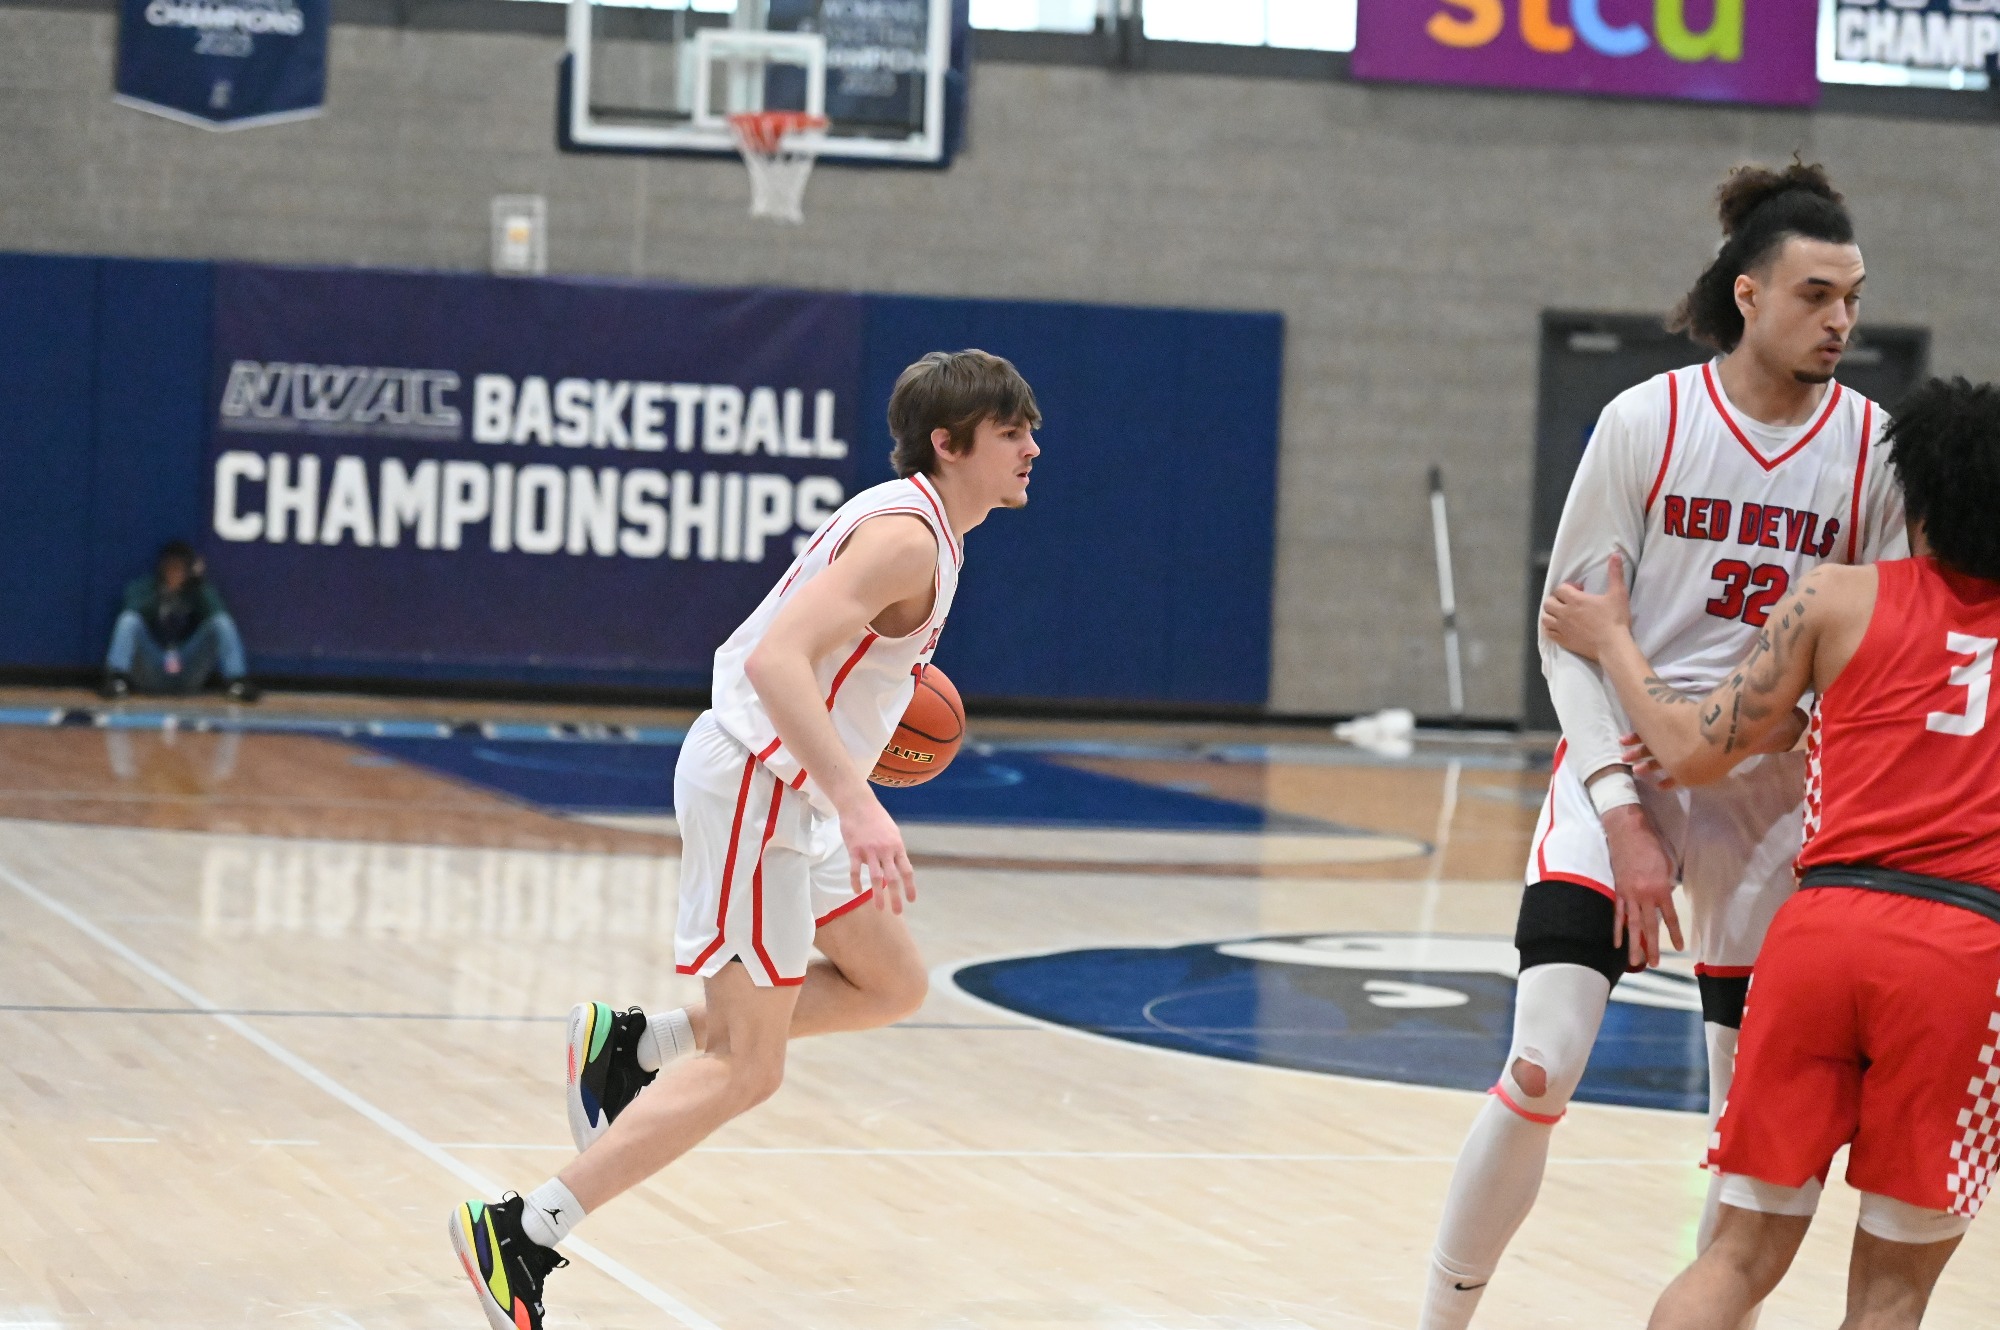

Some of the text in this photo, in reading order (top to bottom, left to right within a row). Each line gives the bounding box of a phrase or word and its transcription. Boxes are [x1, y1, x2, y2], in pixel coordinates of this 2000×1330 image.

[220, 359, 848, 459] NWAC BASKETBALL
[213, 450, 845, 562] CHAMPIONSHIPS
[1664, 495, 1732, 542] RED
[1706, 558, 1789, 627] 32
[1926, 630, 1998, 736] 3
